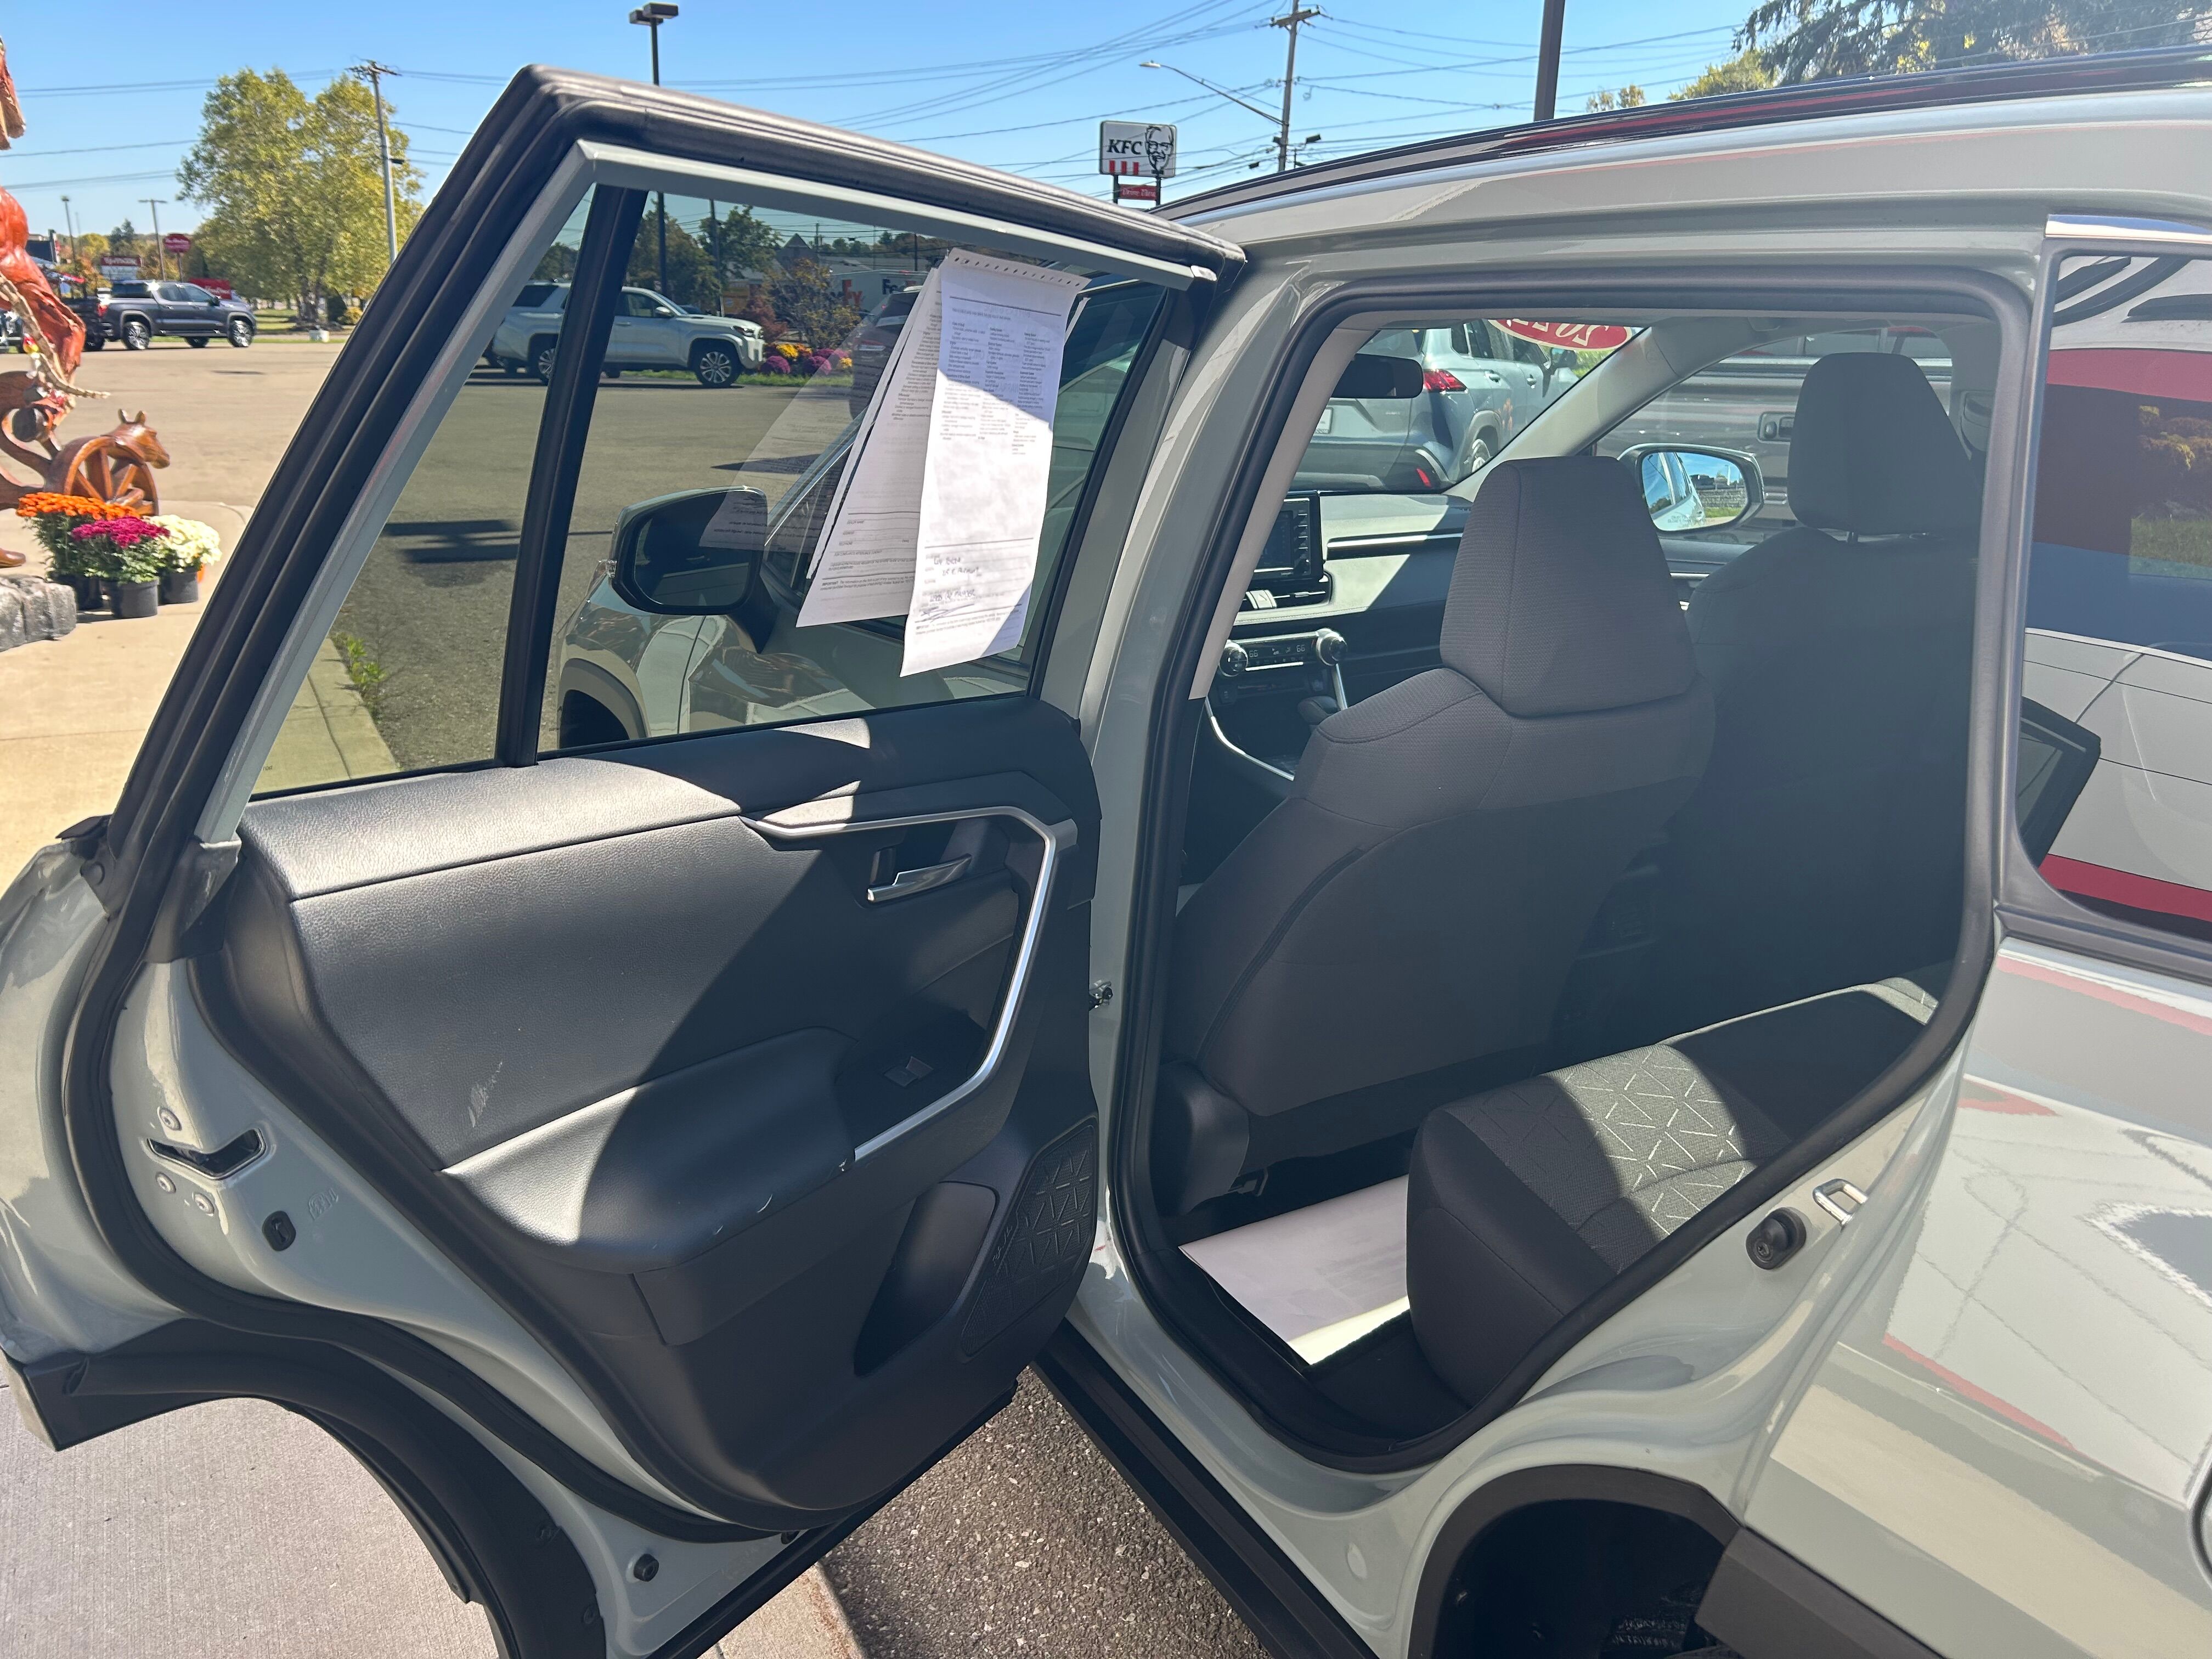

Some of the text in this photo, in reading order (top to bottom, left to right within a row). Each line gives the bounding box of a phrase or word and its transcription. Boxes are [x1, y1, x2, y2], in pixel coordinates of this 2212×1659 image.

[1107, 139, 1142, 155] KFC
[1249, 644, 1306, 658] 66 66
